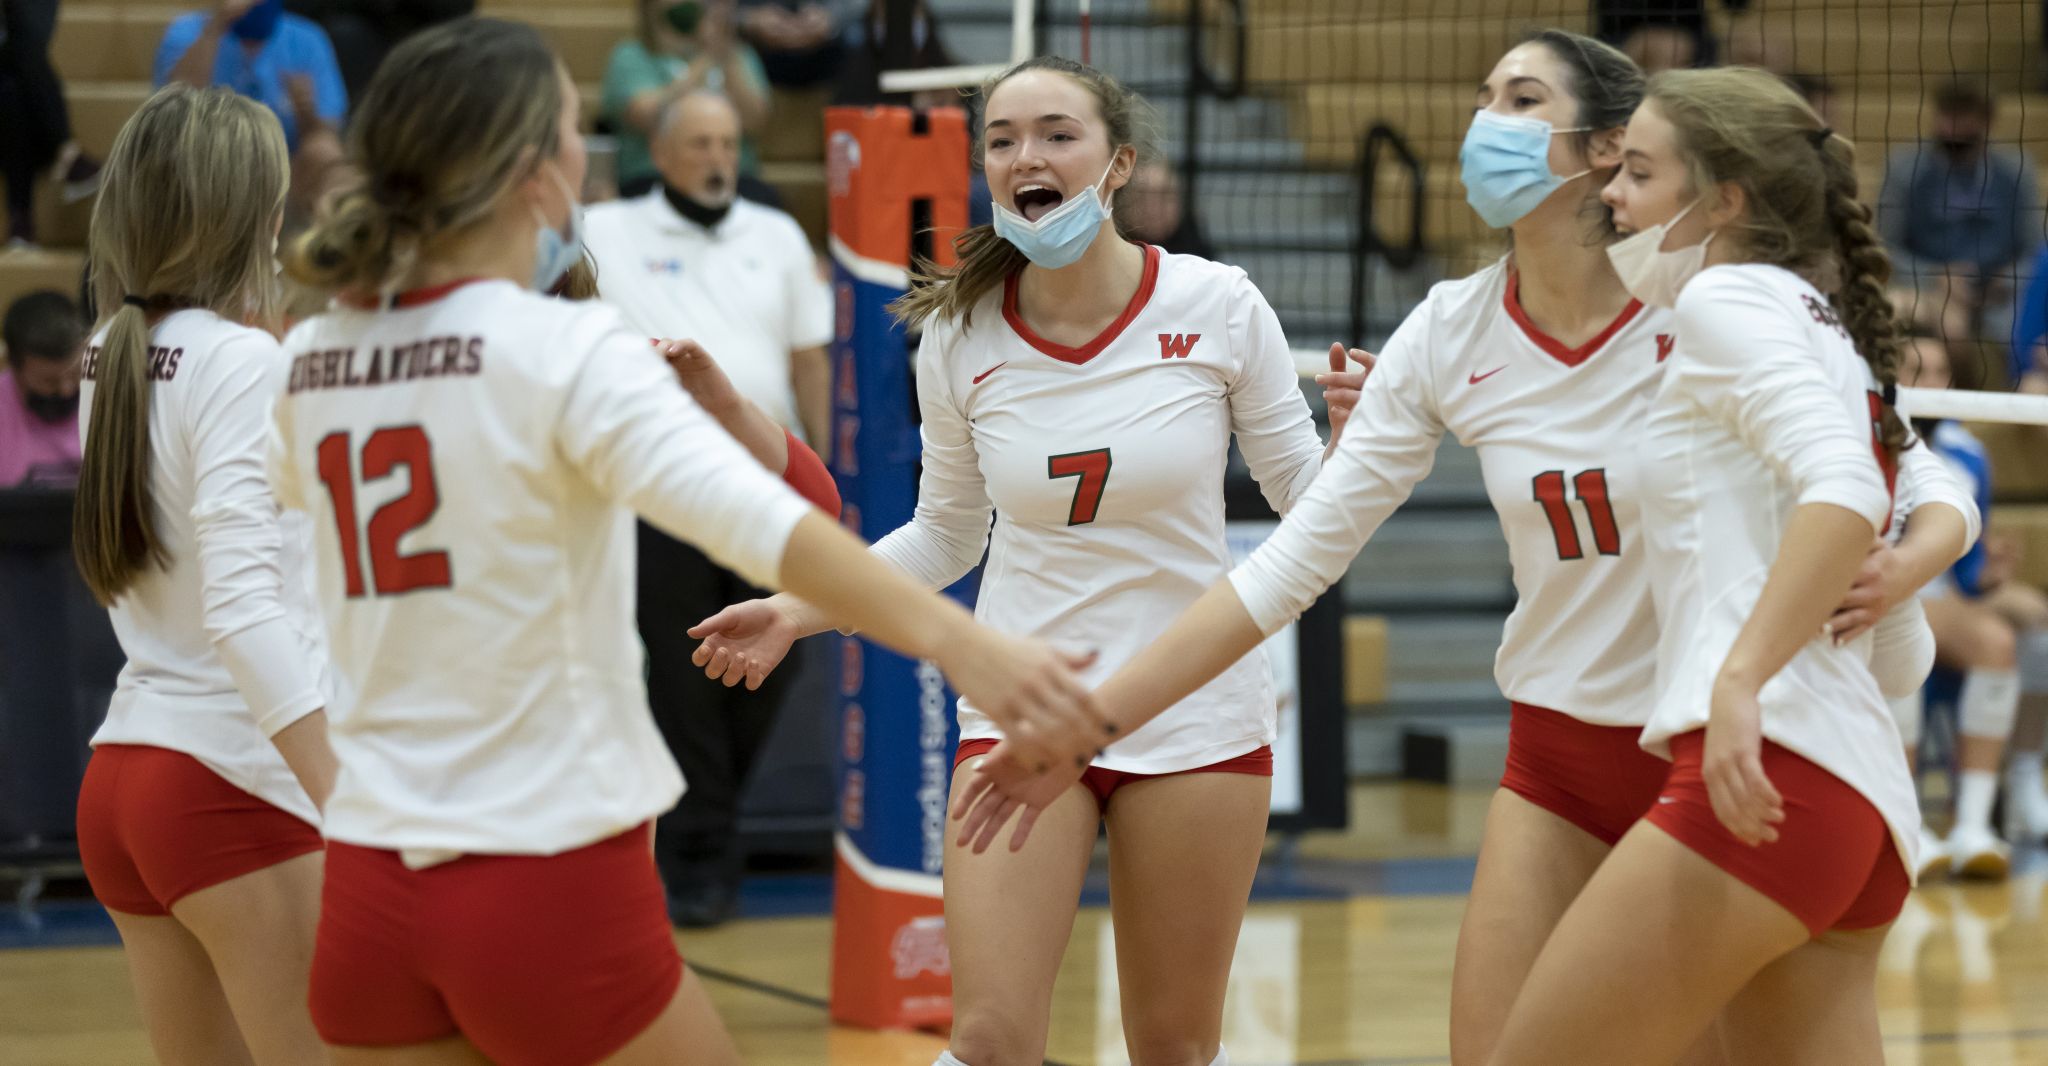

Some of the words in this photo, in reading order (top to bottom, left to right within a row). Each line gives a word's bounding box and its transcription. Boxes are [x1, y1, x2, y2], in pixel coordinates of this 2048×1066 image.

[1158, 334, 1201, 359] W
[317, 424, 453, 598] 12
[1047, 448, 1112, 526] 7
[1533, 468, 1620, 560] 11
